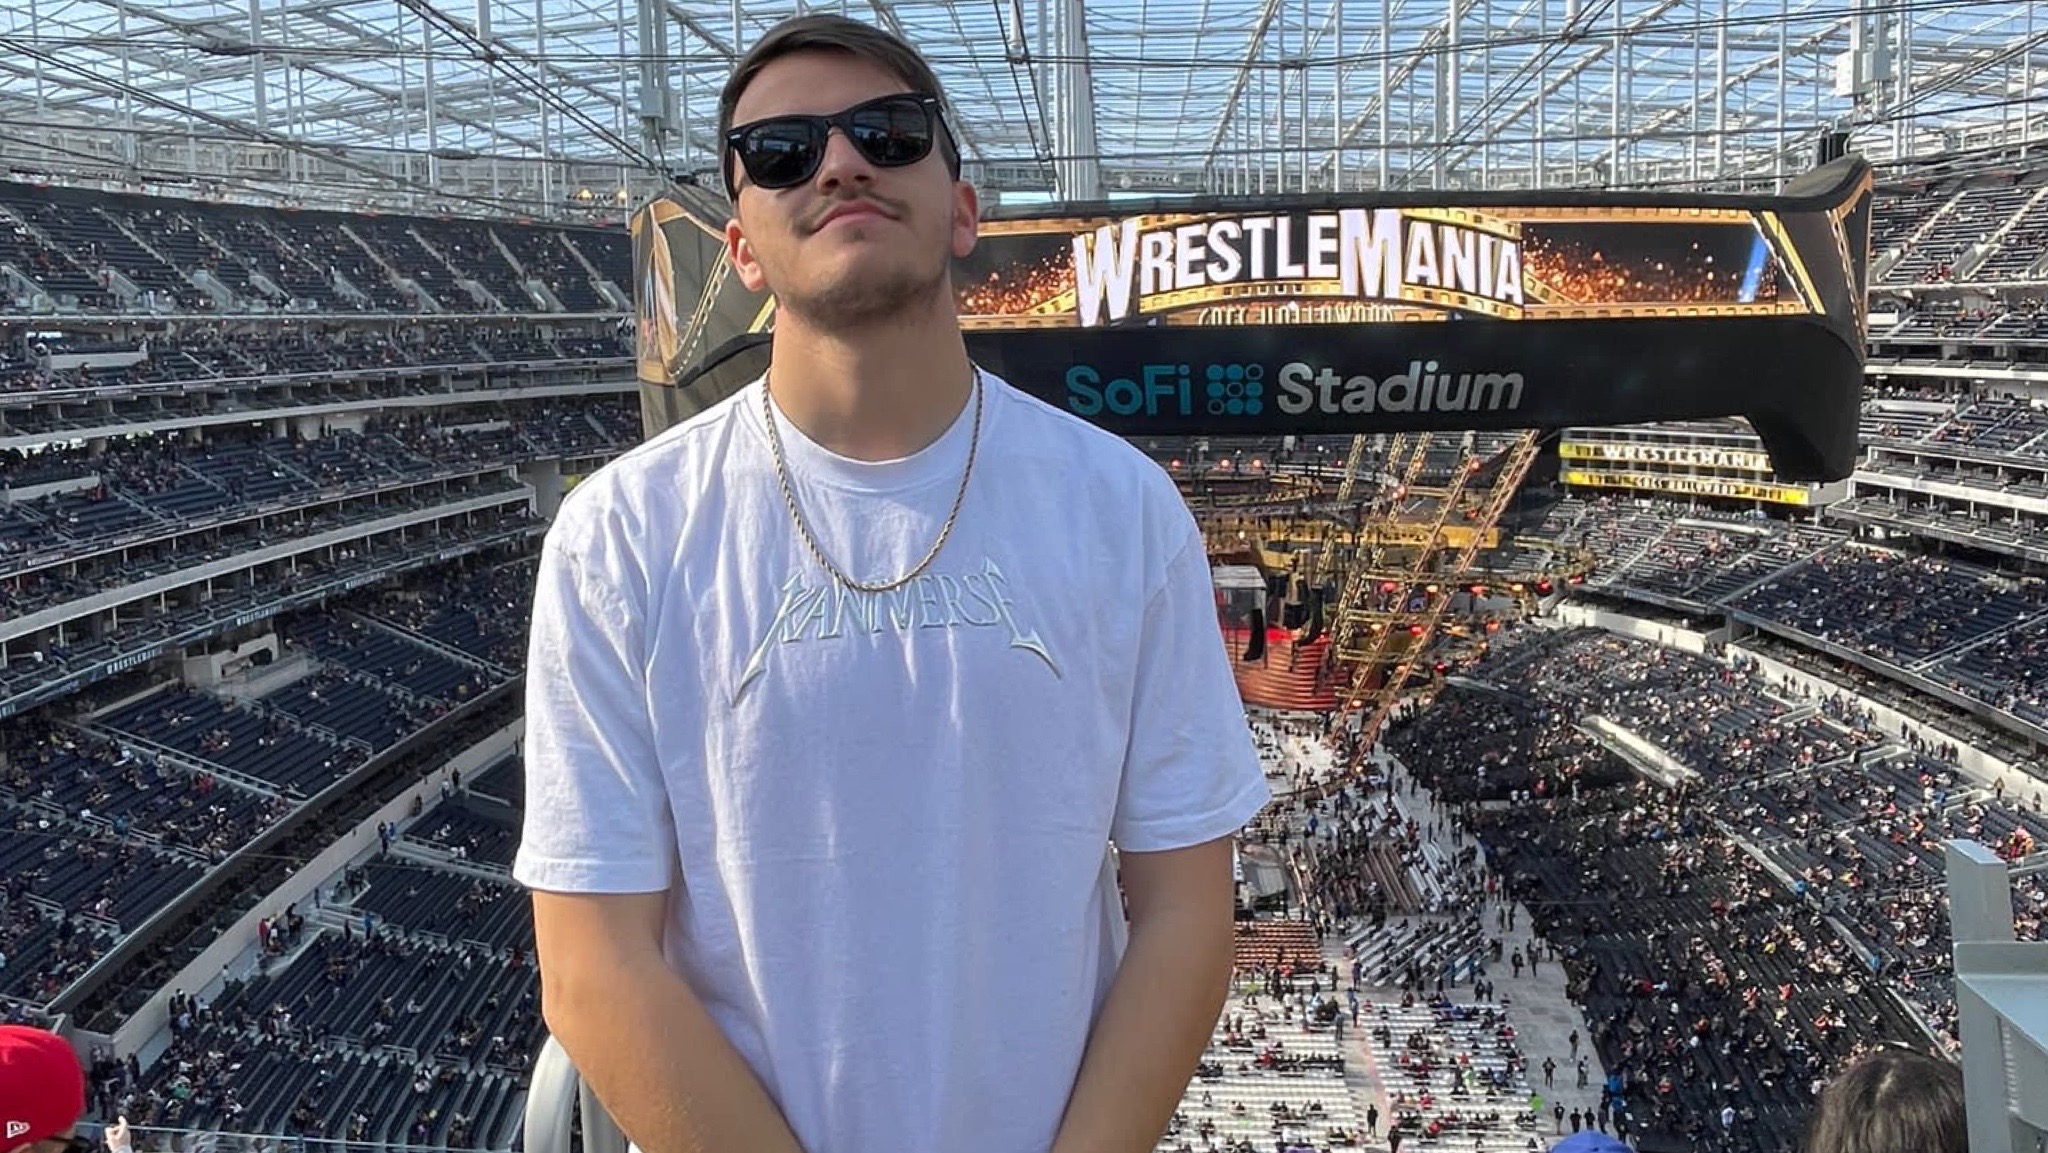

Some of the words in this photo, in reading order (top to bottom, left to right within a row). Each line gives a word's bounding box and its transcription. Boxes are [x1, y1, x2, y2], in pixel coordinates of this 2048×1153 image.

[1073, 208, 1523, 328] WRESTLEMANIA
[1067, 364, 1193, 416] SoFi
[1276, 361, 1524, 415] Stadium
